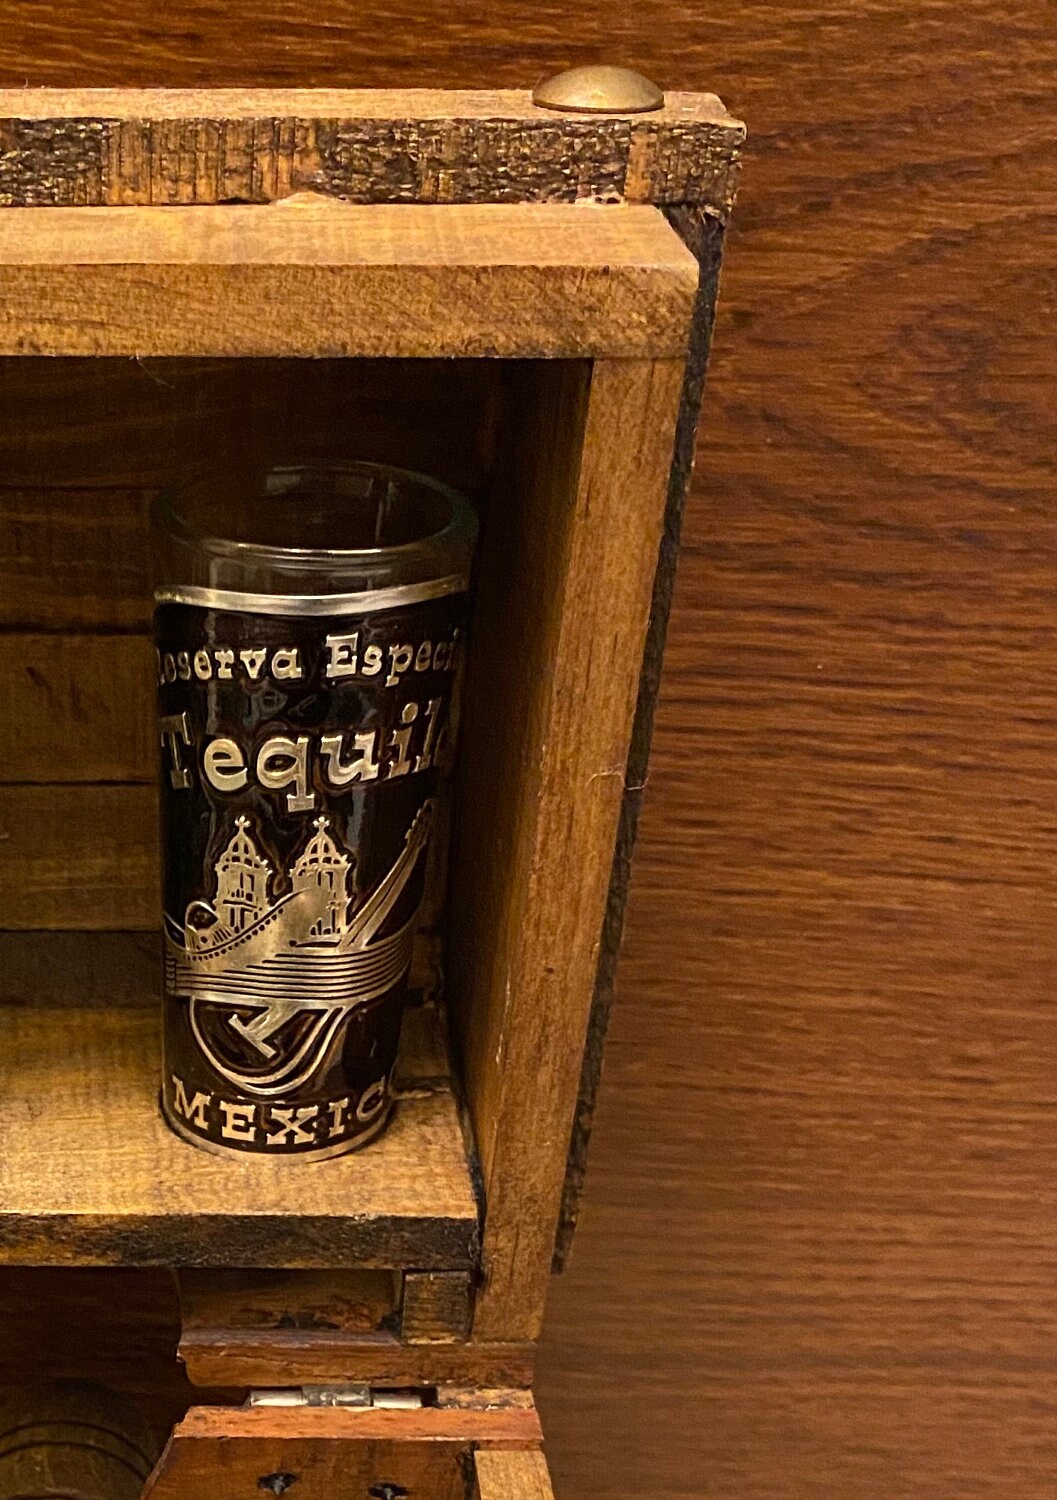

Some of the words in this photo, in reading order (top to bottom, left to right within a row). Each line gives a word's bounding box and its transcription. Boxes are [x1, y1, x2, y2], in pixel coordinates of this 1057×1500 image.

[156, 648, 302, 686] eserva
[158, 697, 443, 812] Tequil
[172, 1075, 387, 1145] MEXIC
